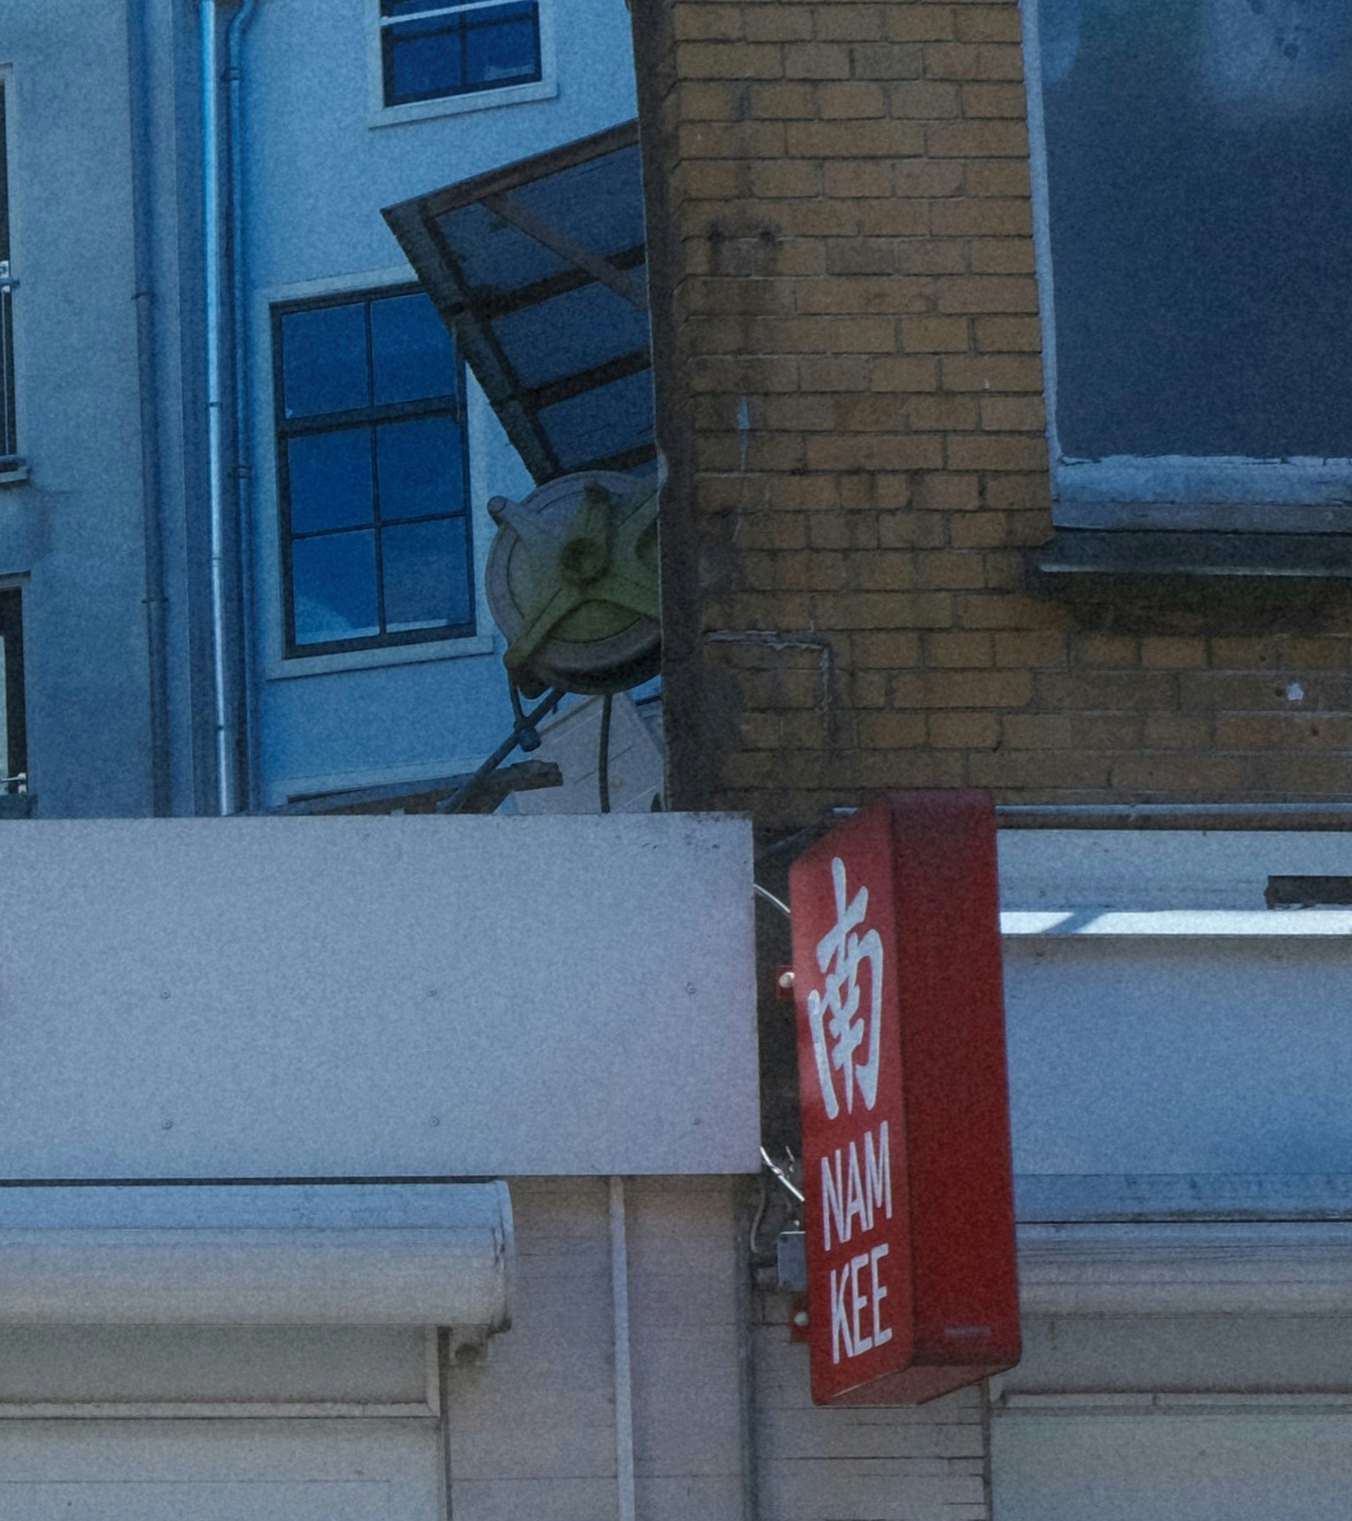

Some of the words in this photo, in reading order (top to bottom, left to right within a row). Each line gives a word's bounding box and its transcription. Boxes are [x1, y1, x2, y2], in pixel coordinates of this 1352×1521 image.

[807, 857, 884, 1120] 南
[821, 1120, 893, 1251] NAM
[829, 1242, 893, 1365] KEE
